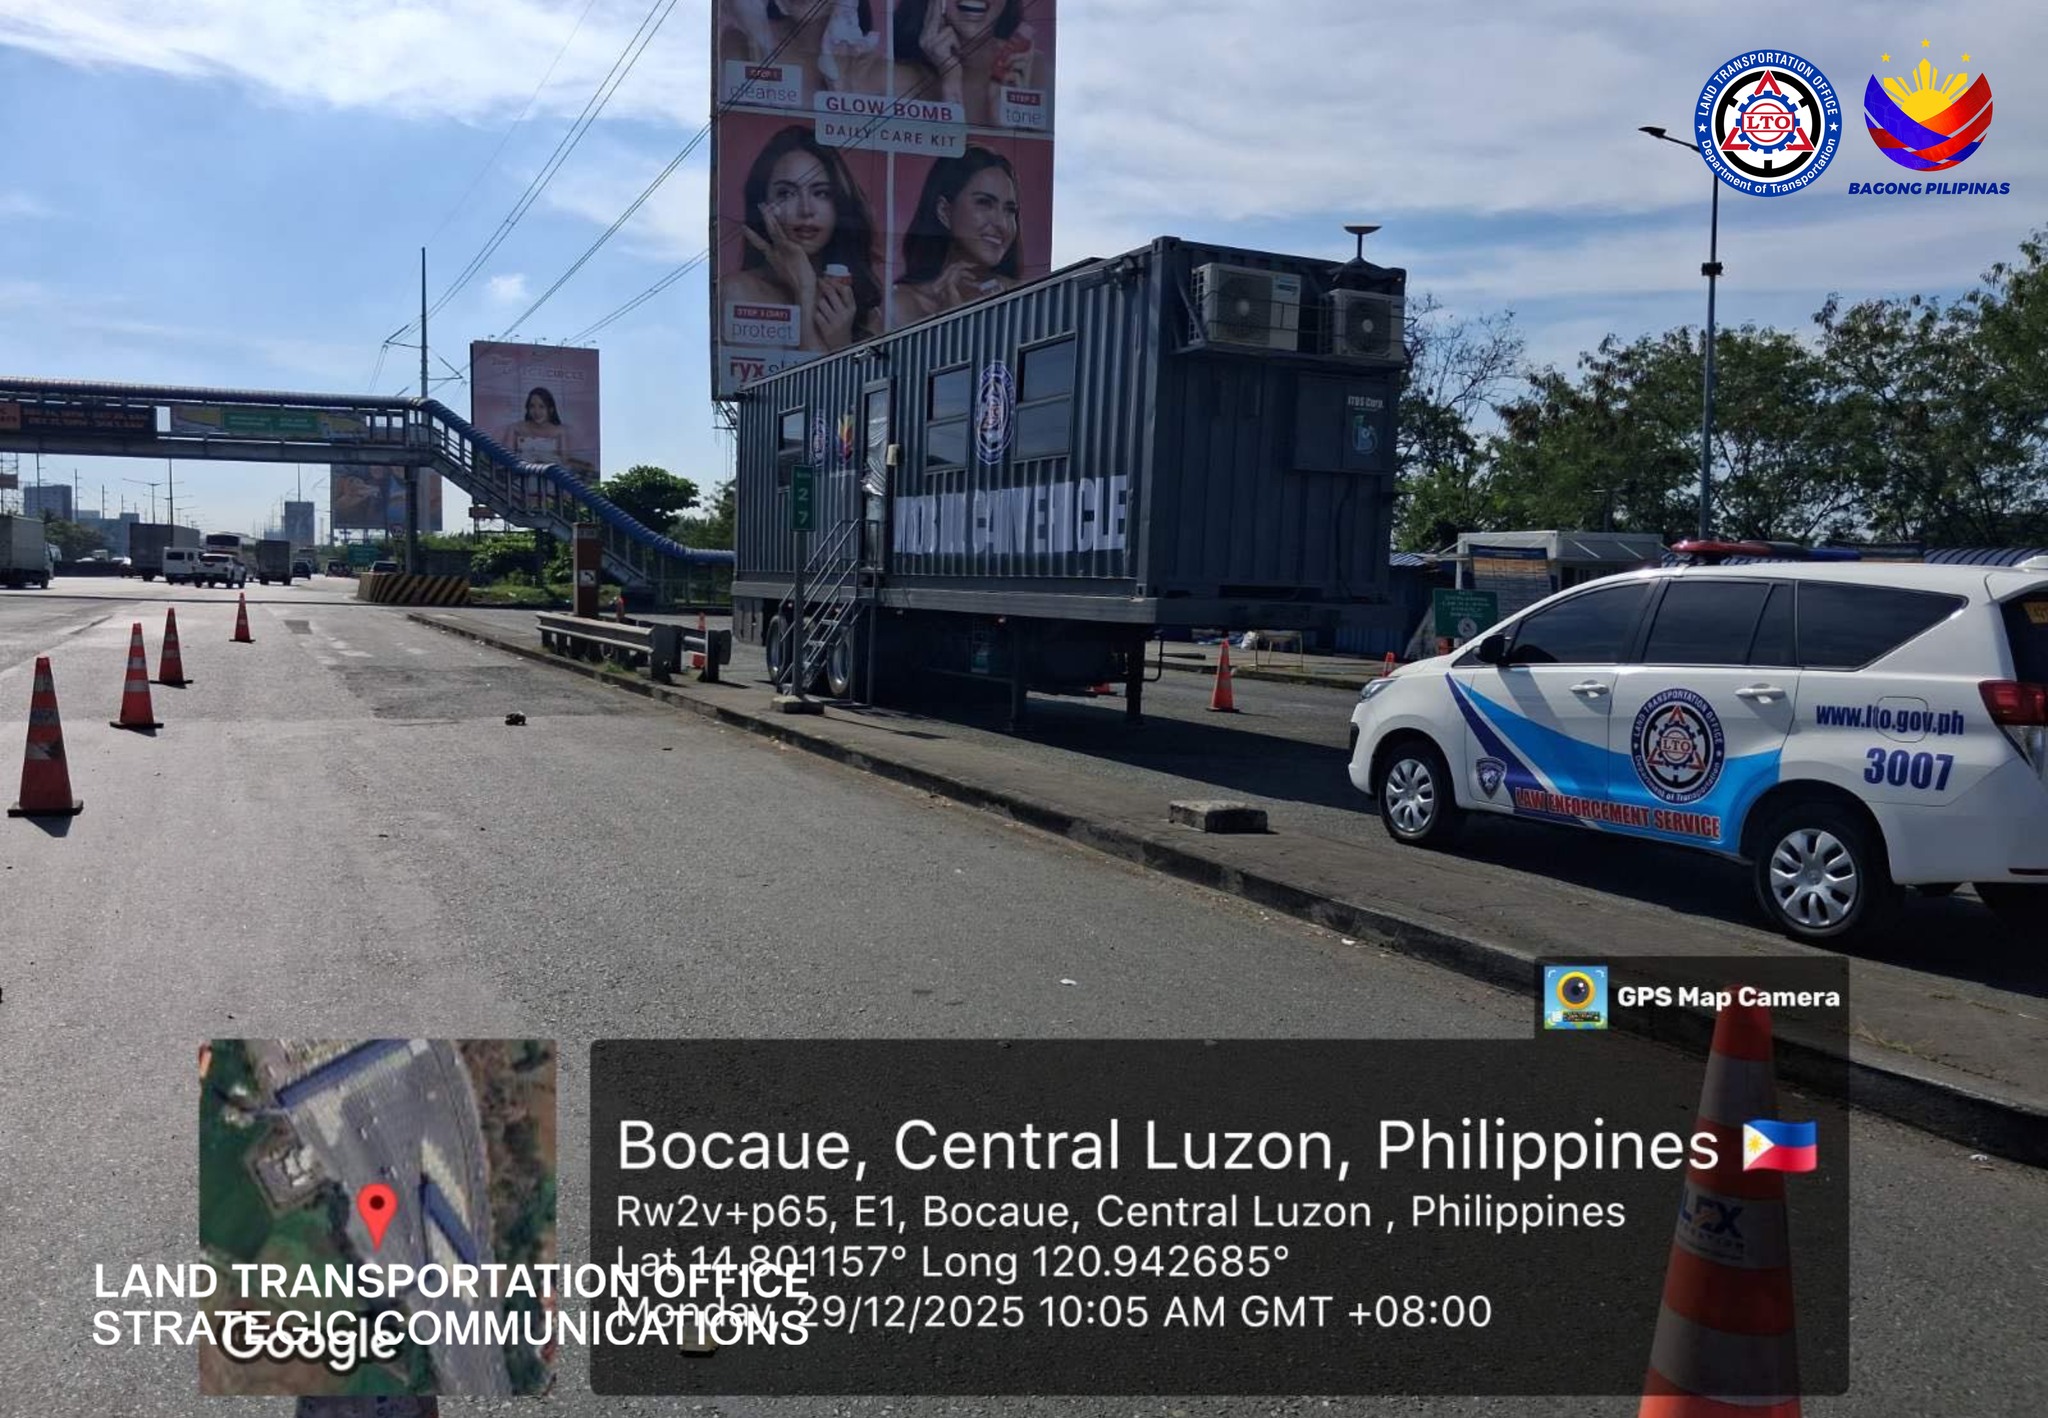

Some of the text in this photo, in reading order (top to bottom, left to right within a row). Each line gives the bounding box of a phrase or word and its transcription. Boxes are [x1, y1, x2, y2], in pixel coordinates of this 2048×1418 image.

[826, 96, 953, 121] GLOW BOMB
[1006, 108, 1042, 125] tone
[825, 123, 956, 147] DAILY CARE KIT
[732, 322, 792, 340] protect
[730, 361, 765, 383] ryx
[1633, 690, 1723, 745] LAND TRANSPORTATION OFFICE
[1816, 704, 1965, 736] www.lto.gov.ph
[1663, 739, 1692, 752] LTO
[1863, 747, 1955, 792] 3007
[1665, 792, 1675, 801] of
[1515, 786, 1721, 839] LAW ENFORCEMENT SERVICE
